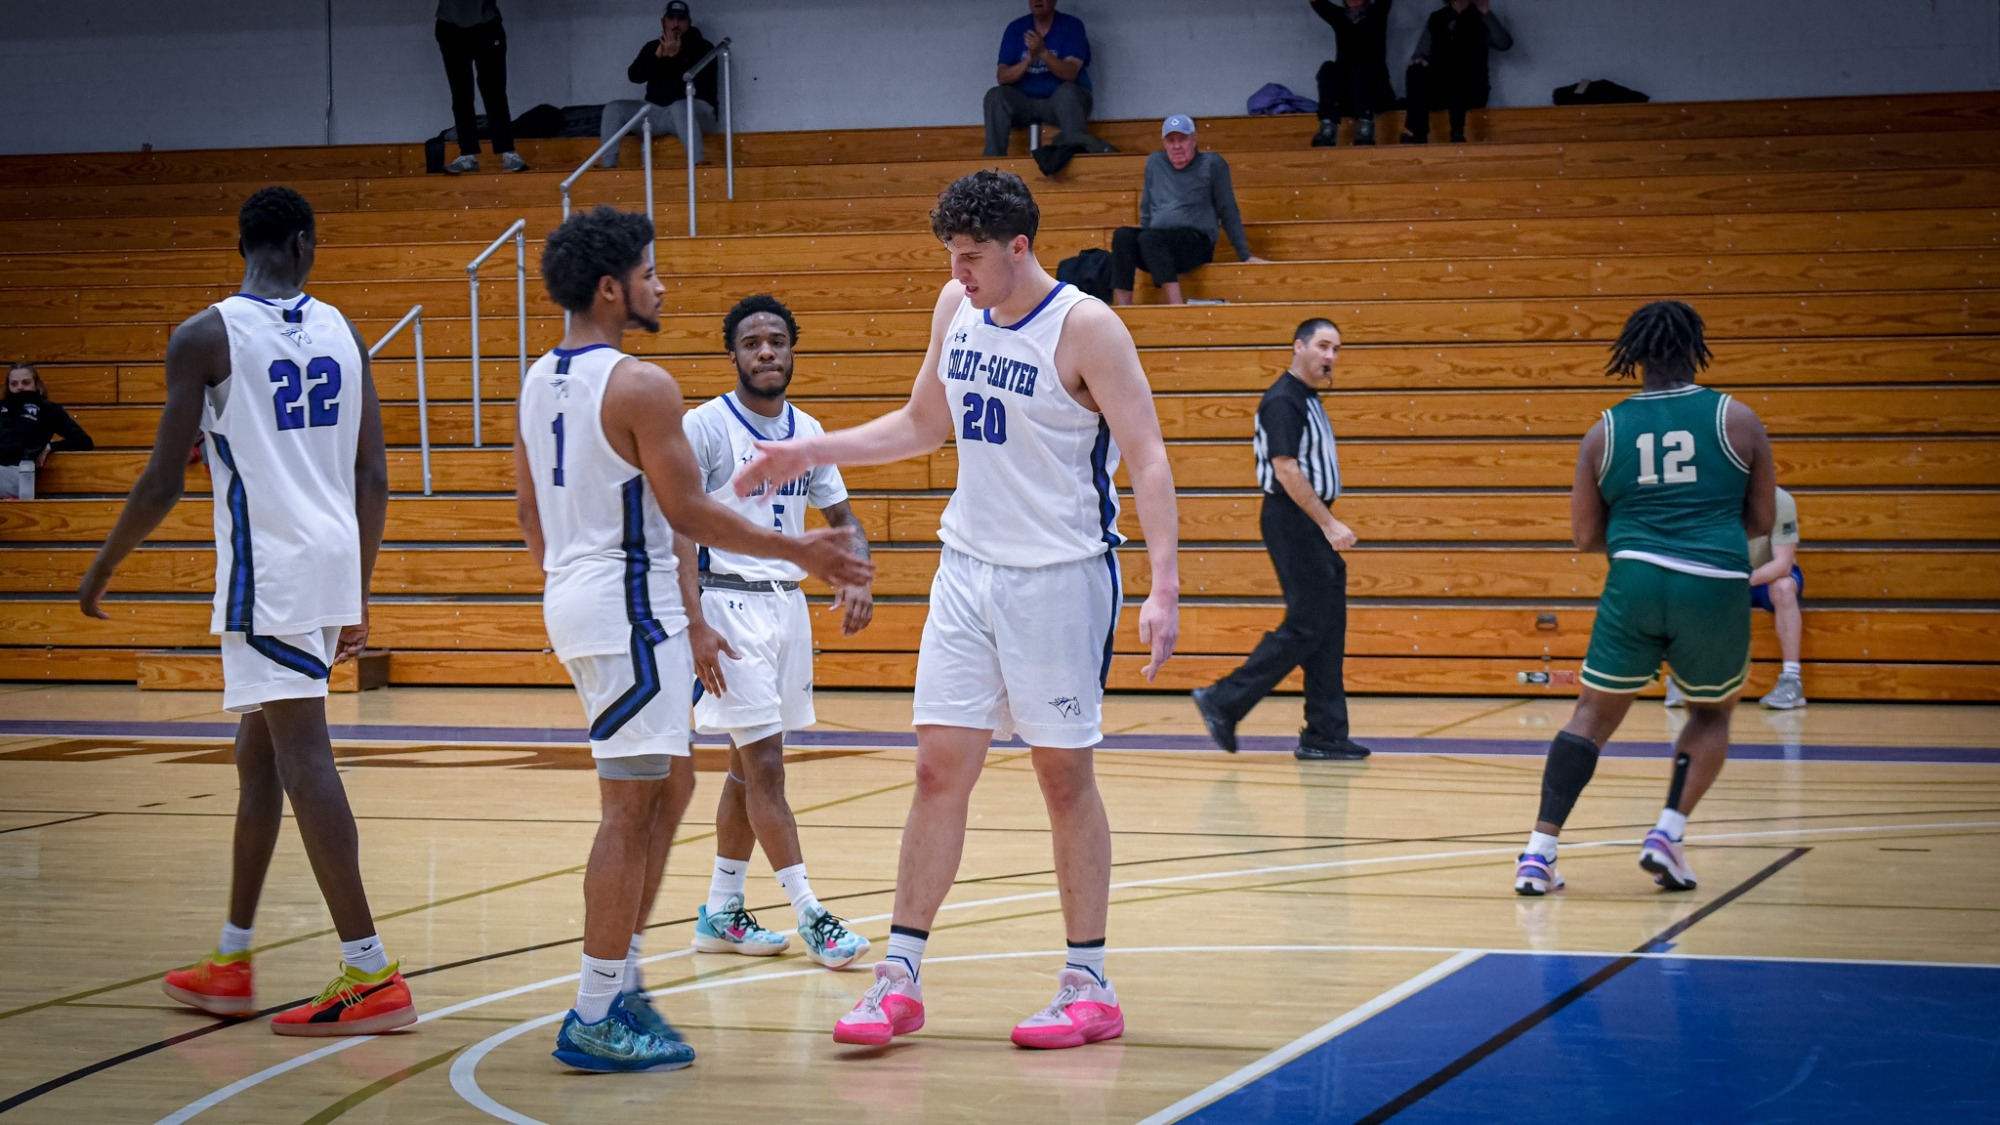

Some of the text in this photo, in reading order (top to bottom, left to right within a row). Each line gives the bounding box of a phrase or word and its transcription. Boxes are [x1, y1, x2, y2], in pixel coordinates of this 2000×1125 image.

[268, 355, 342, 431] 22
[947, 348, 1039, 397] COLBY-SAWYER
[962, 391, 1007, 445] 20
[551, 412, 565, 487] 1
[1636, 429, 1698, 485] 12
[772, 504, 785, 535] 5
